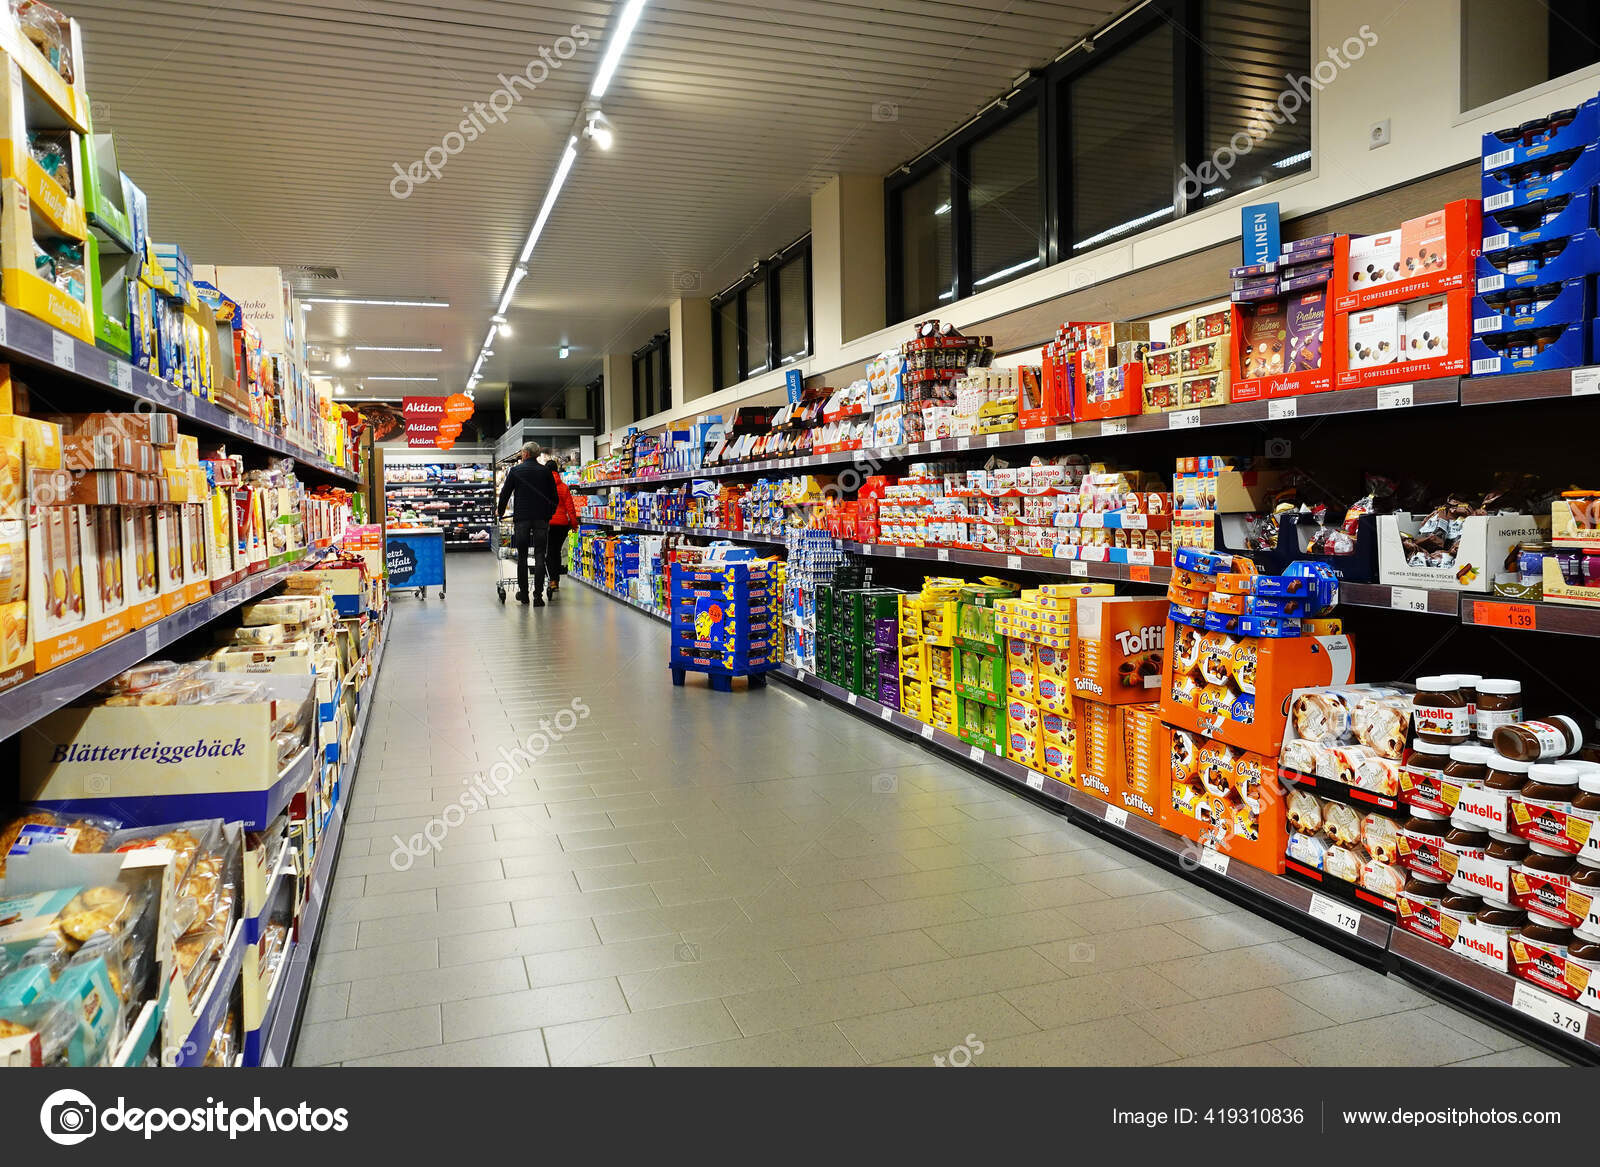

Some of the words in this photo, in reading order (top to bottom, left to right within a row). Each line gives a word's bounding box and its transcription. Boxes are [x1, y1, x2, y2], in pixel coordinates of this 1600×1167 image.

[1254, 213, 1269, 264] ALINEN
[405, 402, 444, 412] Aktion
[1395, 397, 1411, 406] 2.59
[1187, 415, 1200, 424] 1.99
[1282, 409, 1295, 417] 3.99
[407, 424, 438, 432] Aktion
[387, 549, 404, 558] etzt
[387, 557, 411, 568] elfalt
[388, 566, 413, 575] PACKEN
[1409, 601, 1425, 610] 1.99
[1508, 615, 1532, 626] 1.39
[1200, 638, 1233, 659] Chocisserie
[1073, 677, 1103, 696] Toffifee
[1415, 709, 1453, 720] nutella
[49, 737, 246, 764] Blätterteiggebäck
[1199, 750, 1233, 772] Chocisserie
[1080, 773, 1110, 796] Toffifee
[1121, 791, 1154, 816] Toffifee
[1459, 801, 1502, 822] nutella
[1532, 816, 1566, 831] MILLIONEN
[1457, 869, 1504, 892] nutella
[1531, 887, 1566, 905] MILLIONEN
[1336, 913, 1357, 929] 1.79
[1458, 935, 1504, 960] nutella
[1530, 957, 1565, 976] MILLIONEN
[1552, 1011, 1581, 1033] 3.79
